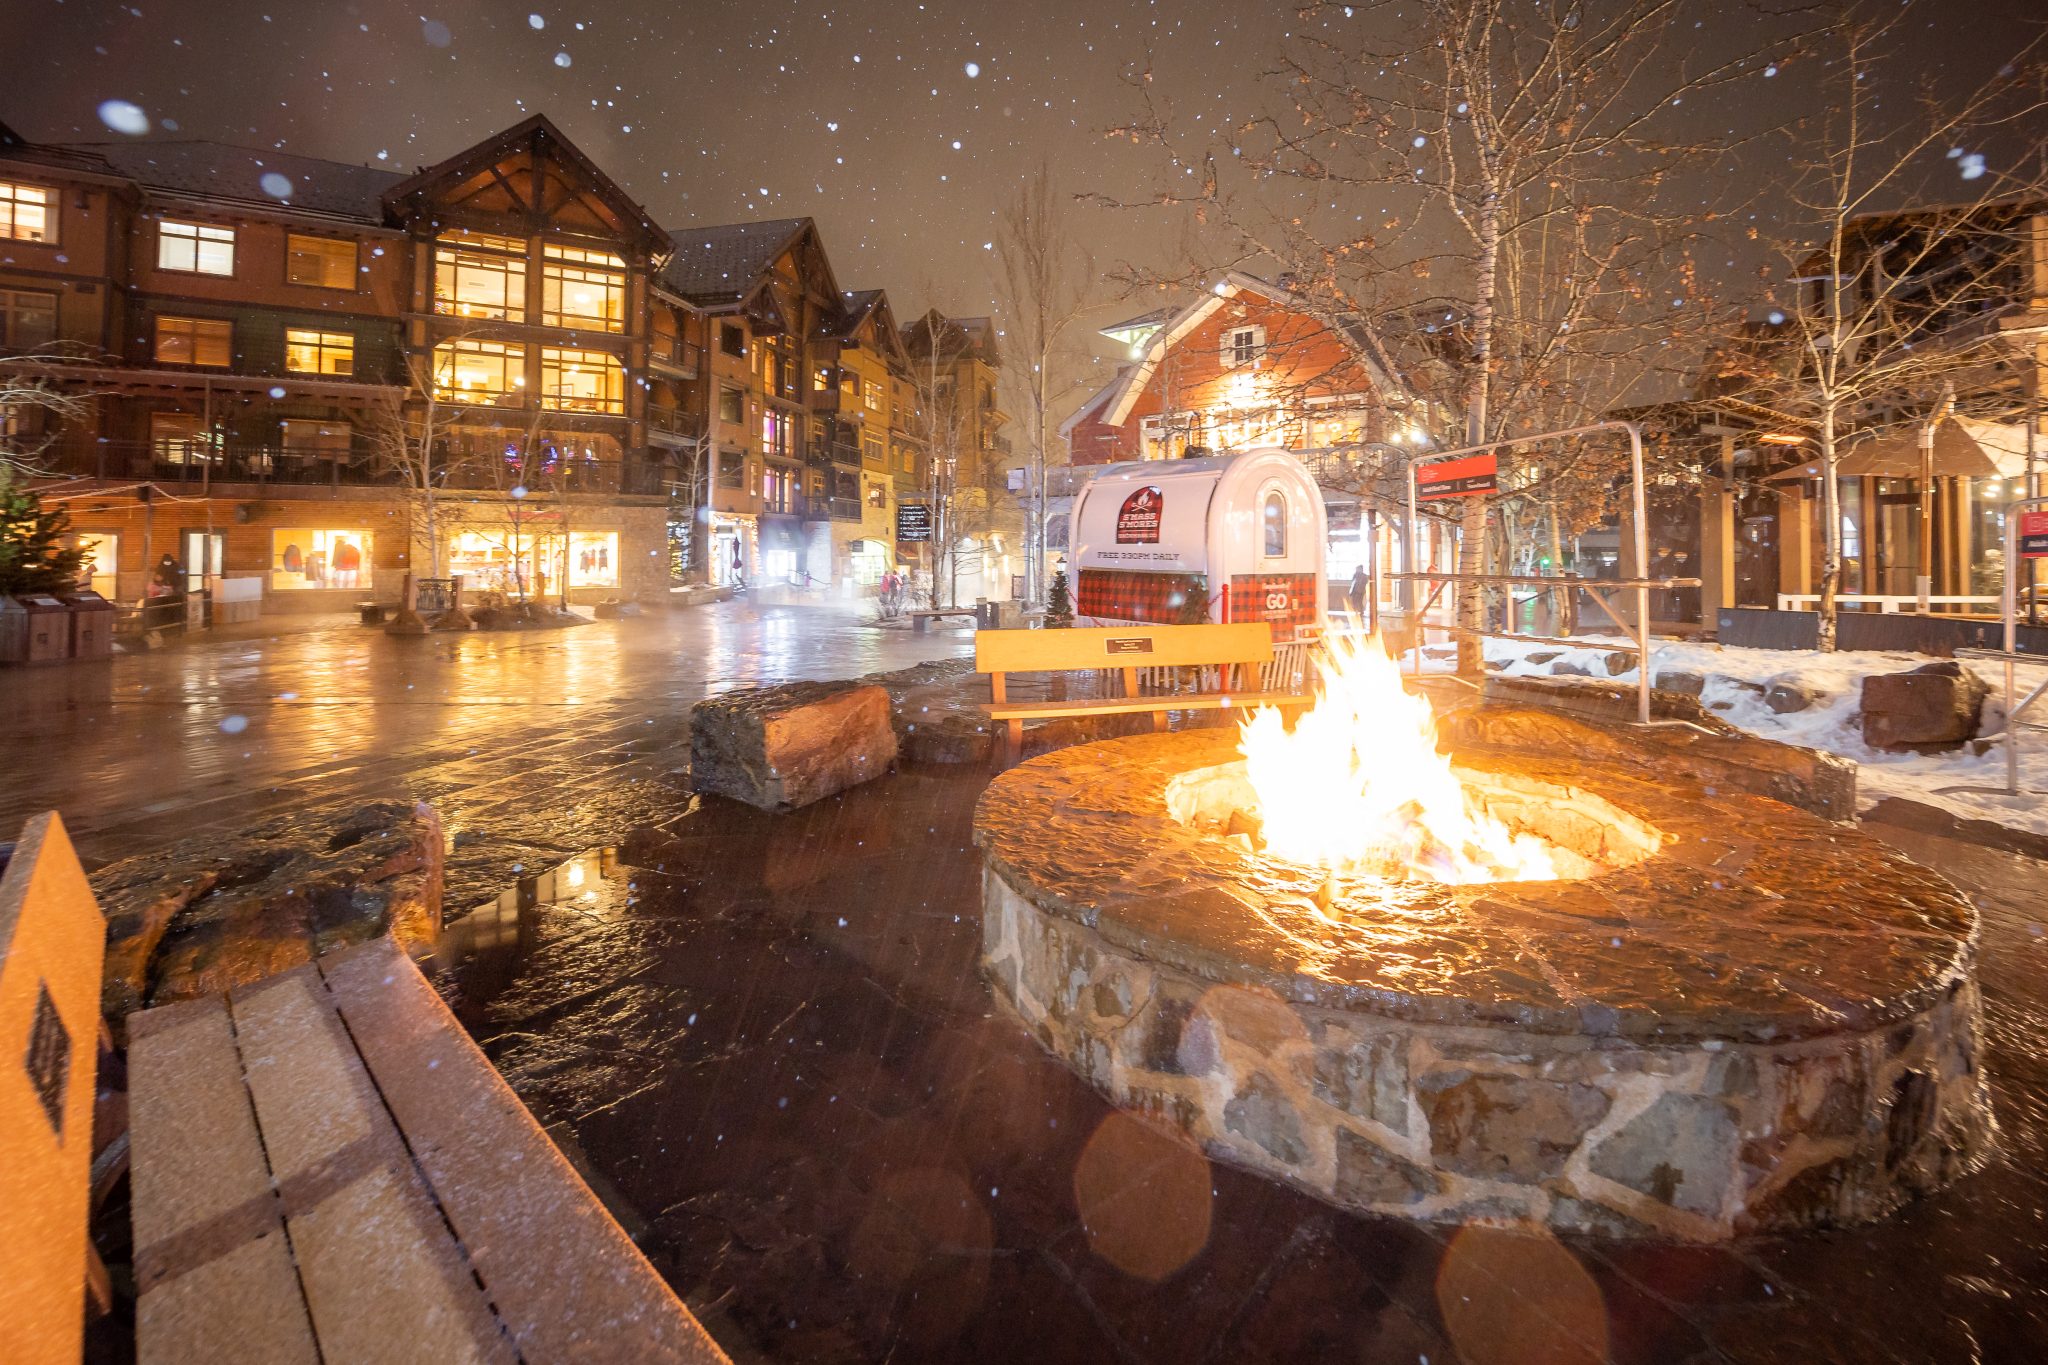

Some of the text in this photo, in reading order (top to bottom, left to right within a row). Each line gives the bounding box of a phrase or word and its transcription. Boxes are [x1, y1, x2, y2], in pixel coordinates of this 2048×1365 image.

[1119, 520, 1158, 528] S'MORES
[1097, 551, 1119, 559] FREE
[1266, 593, 1288, 610] GO
